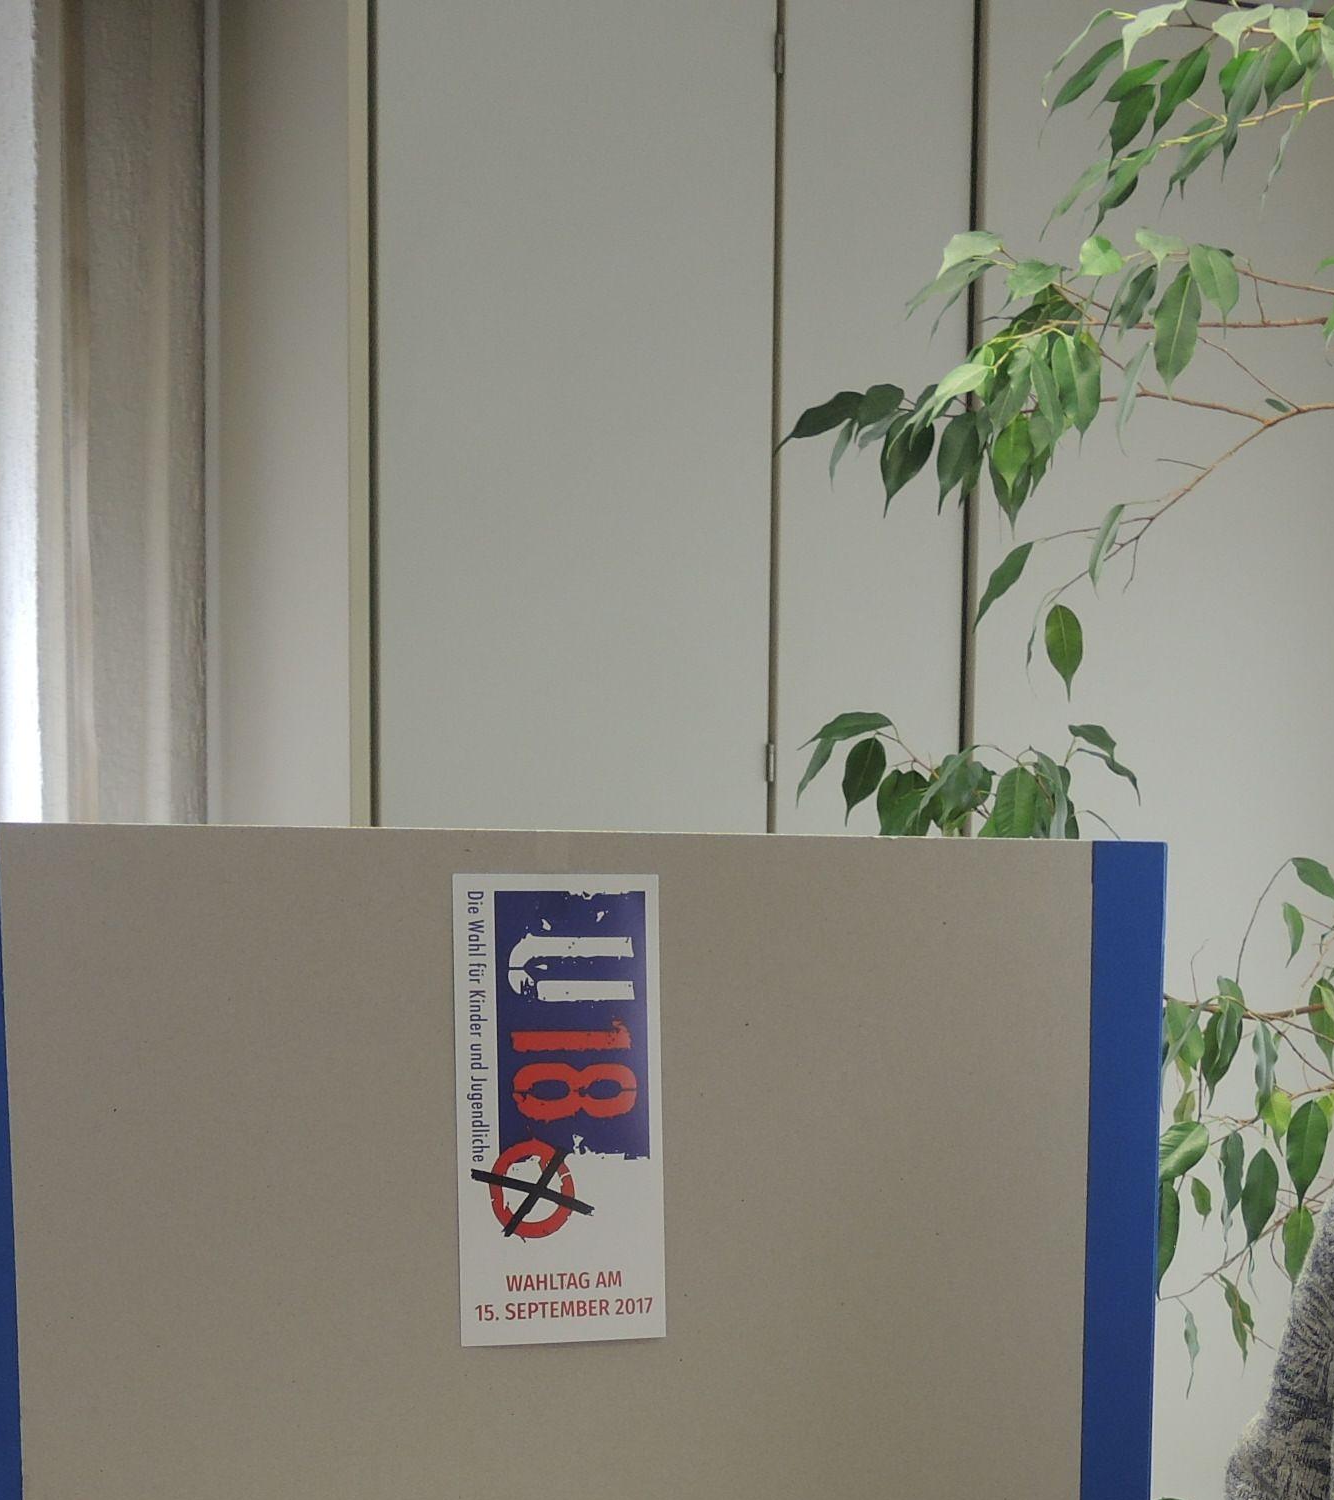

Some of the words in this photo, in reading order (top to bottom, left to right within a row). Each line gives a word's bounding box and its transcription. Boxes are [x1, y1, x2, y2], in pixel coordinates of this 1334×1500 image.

[467, 891, 484, 914] Die
[468, 920, 487, 956] Wahl
[469, 963, 487, 984] für
[469, 990, 488, 1037] Kinder
[470, 1043, 489, 1070] und
[467, 1076, 490, 1163] Jugendliche
[506, 1271, 590, 1292] WAHLTAG
[595, 1270, 623, 1289] AM
[475, 1304, 500, 1322] 15.
[505, 1299, 610, 1321] SEPTEMBER
[615, 1297, 653, 1315] 2017
